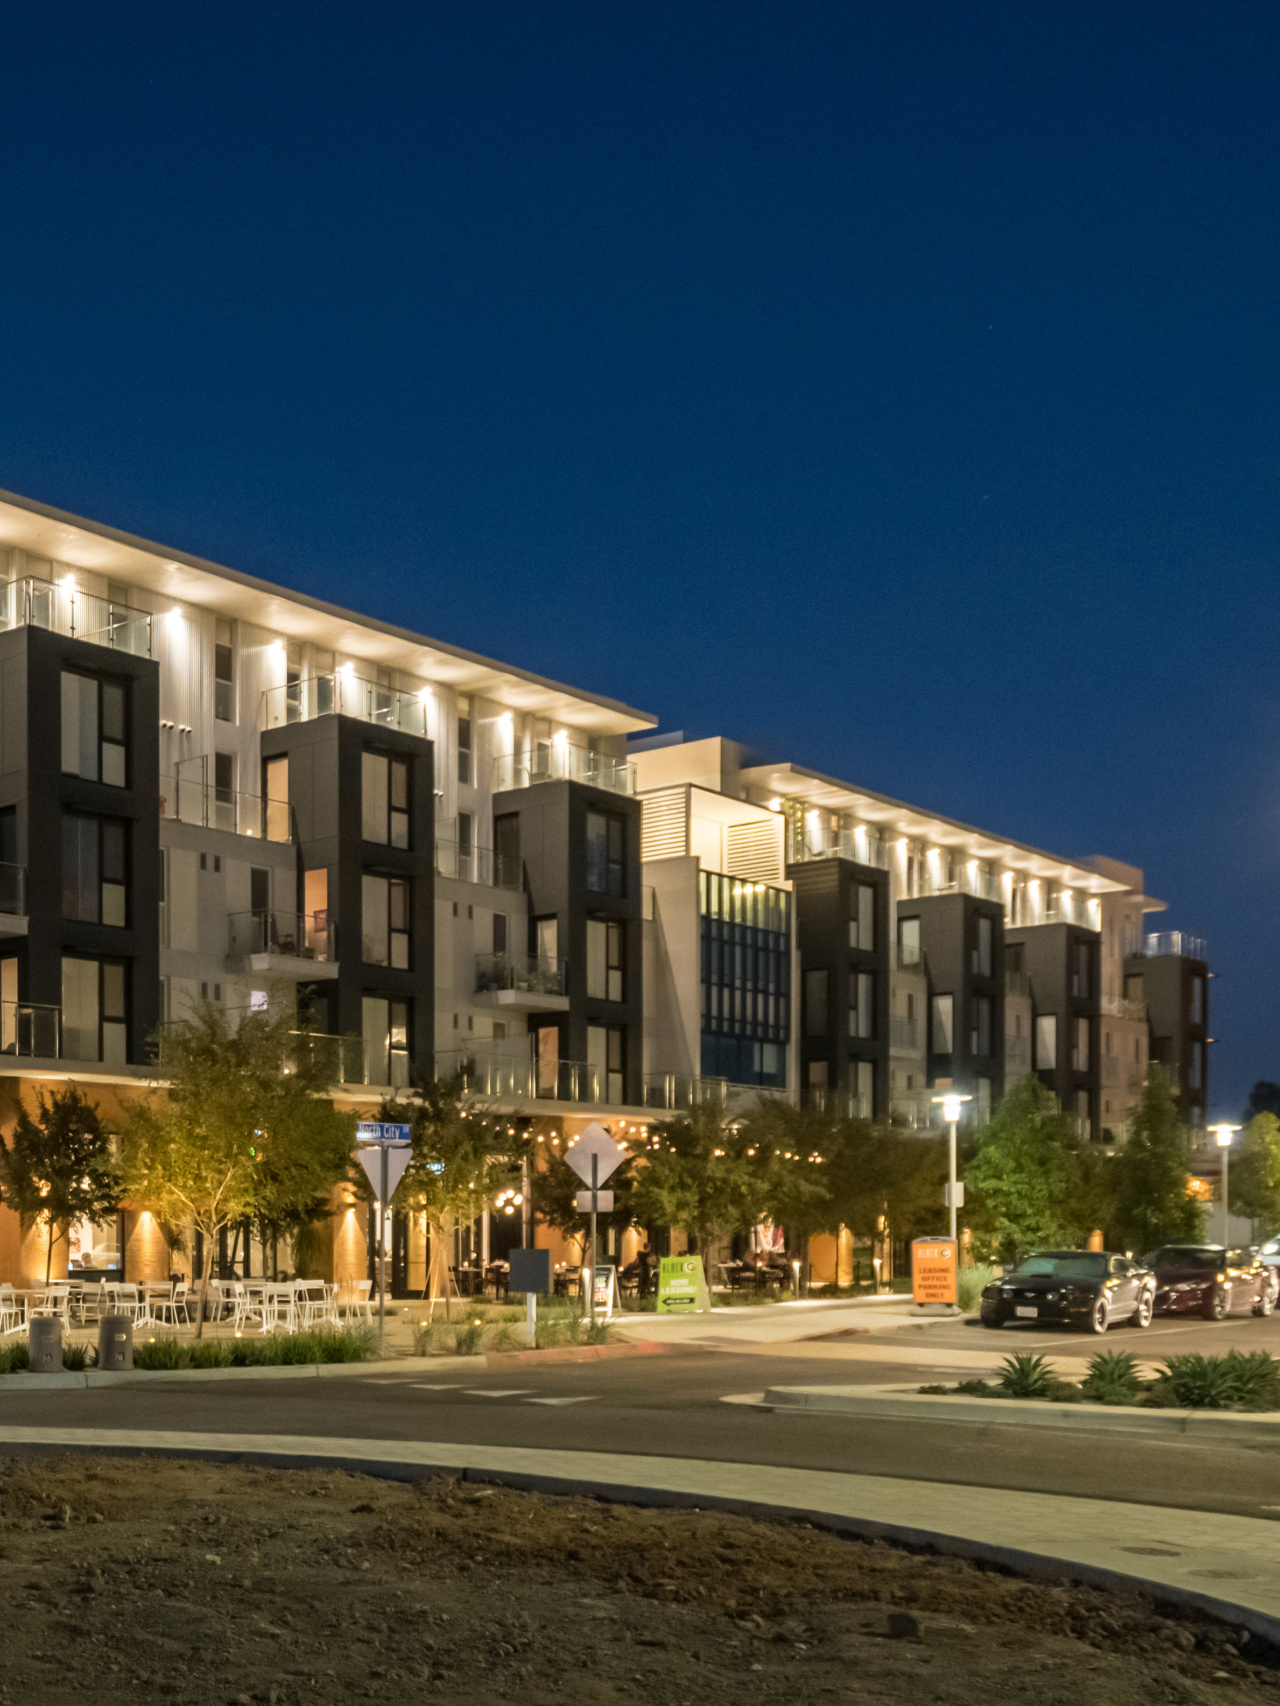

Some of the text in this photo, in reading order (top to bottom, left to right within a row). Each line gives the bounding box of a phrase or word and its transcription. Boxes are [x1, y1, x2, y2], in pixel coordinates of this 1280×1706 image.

[359, 1123, 381, 1138] North
[384, 1124, 400, 1140] City
[671, 1279, 689, 1287] NOW
[661, 1285, 697, 1294] LEASING!
